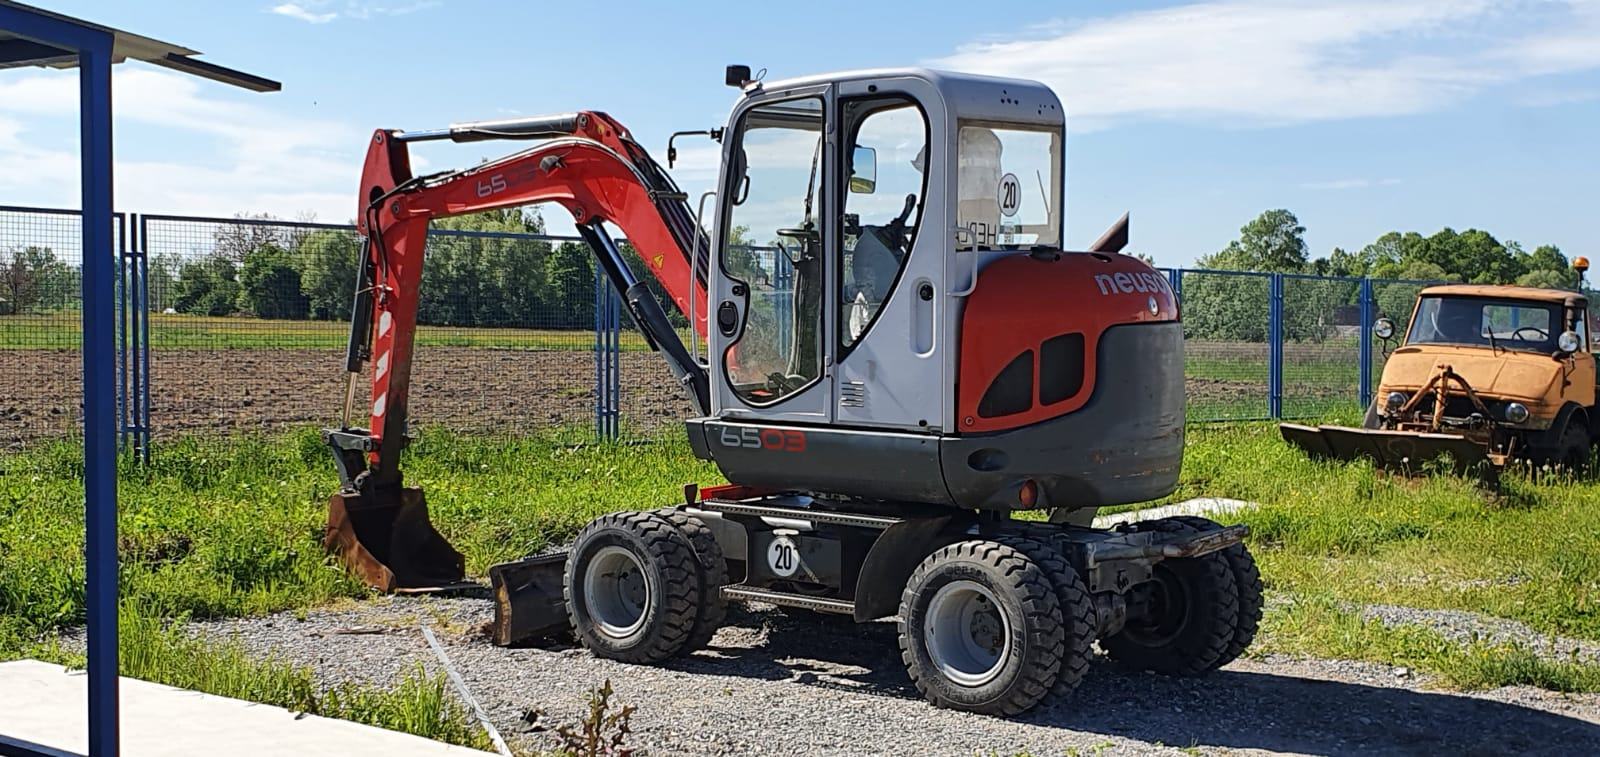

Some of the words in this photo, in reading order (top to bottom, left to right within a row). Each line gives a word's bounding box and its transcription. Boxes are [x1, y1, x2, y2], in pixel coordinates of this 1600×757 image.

[1002, 181, 1016, 209] 20
[720, 426, 806, 452] 6503
[774, 543, 792, 571] 20
